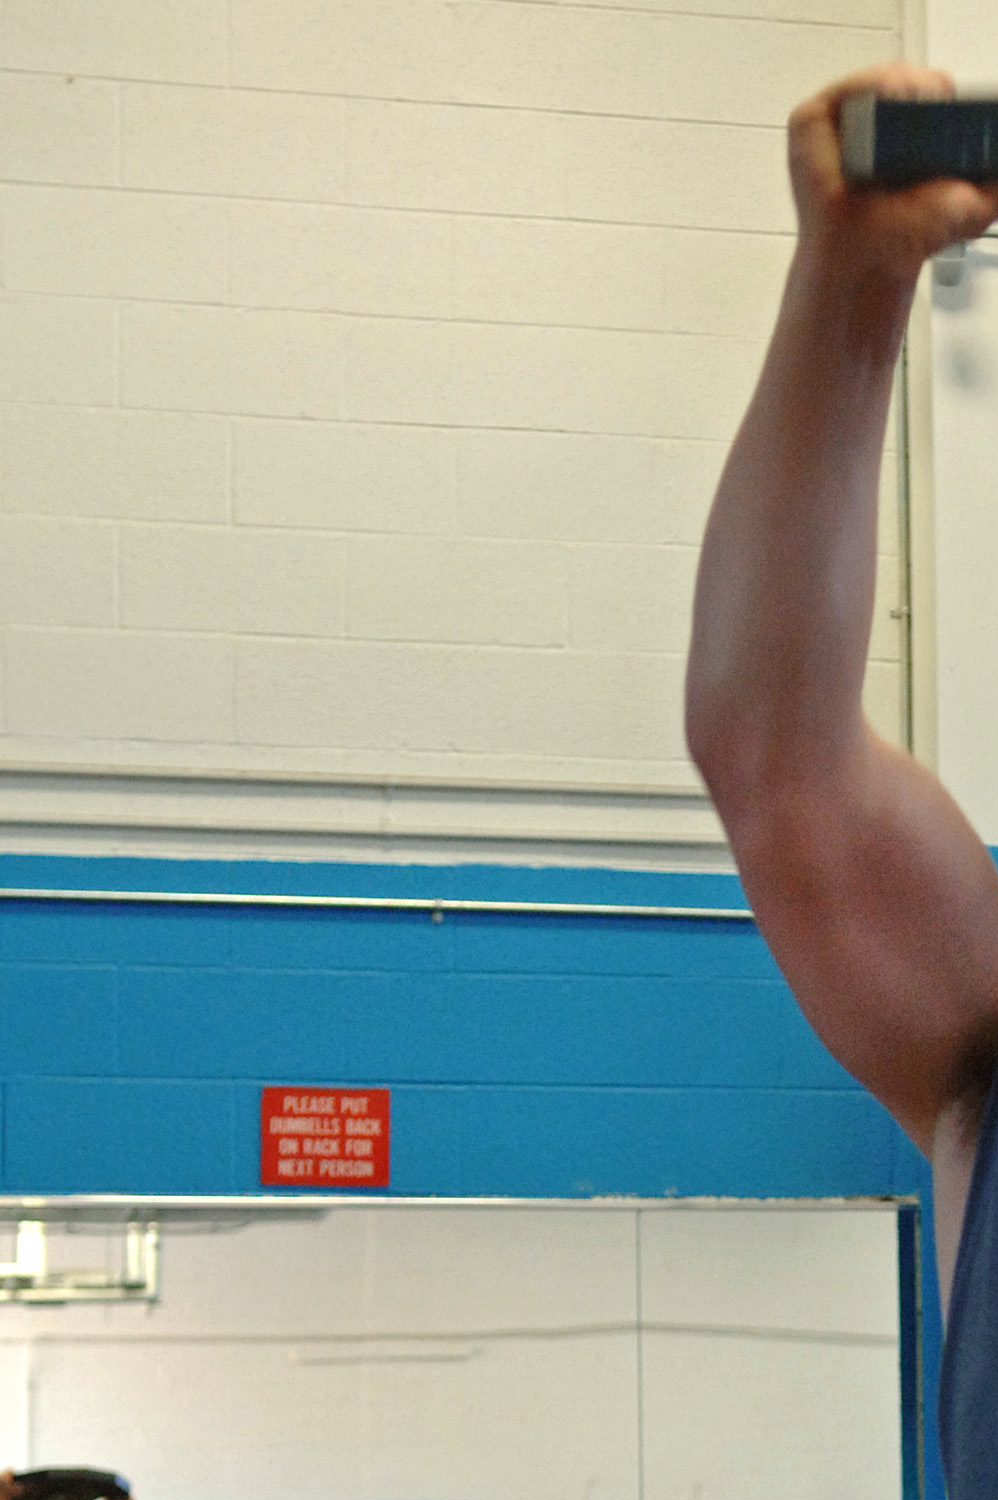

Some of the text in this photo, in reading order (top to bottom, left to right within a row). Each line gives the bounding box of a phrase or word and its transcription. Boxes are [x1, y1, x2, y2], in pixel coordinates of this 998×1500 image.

[282, 1095, 369, 1114] PLEASE PUT
[269, 1116, 382, 1136] DUMBBELLS BACK
[278, 1137, 299, 1155] ON
[345, 1138, 374, 1156] FOR
[277, 1158, 374, 1177] NEXT PERSON
